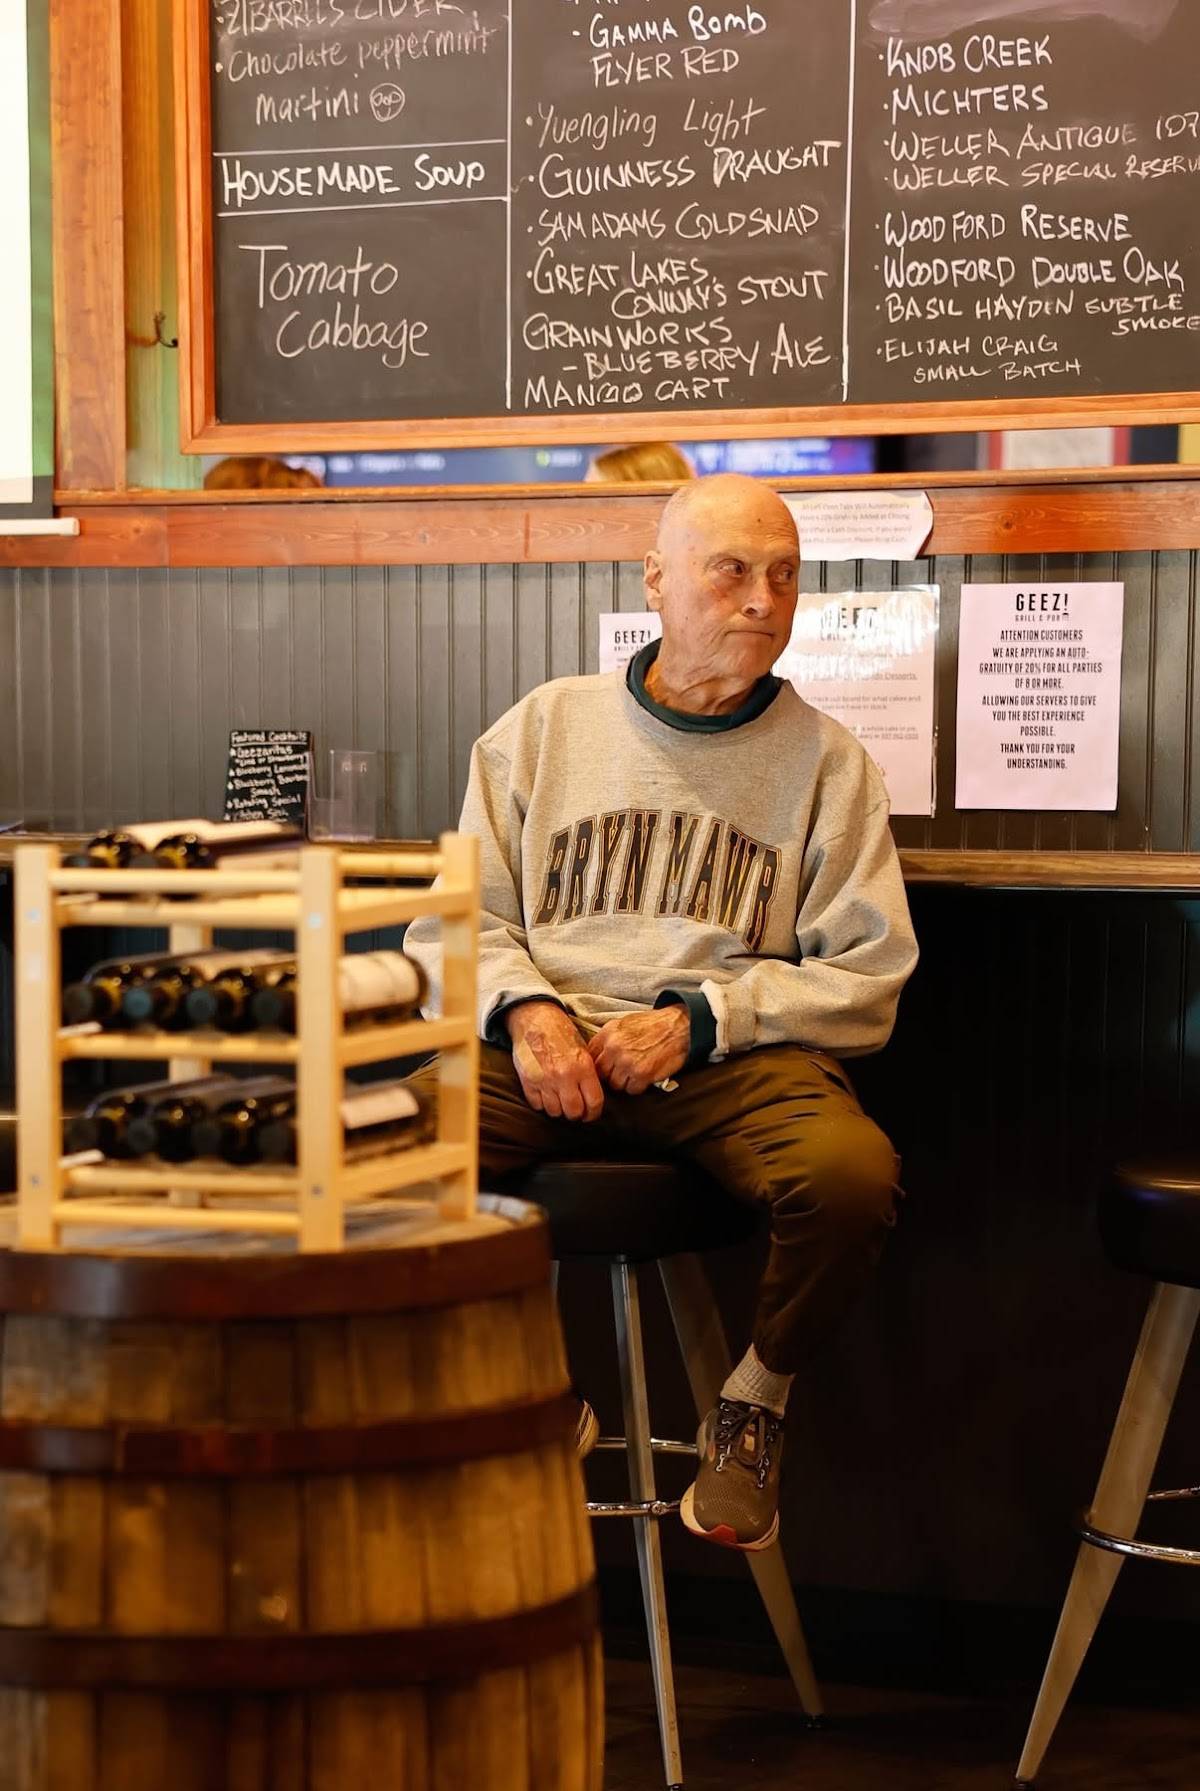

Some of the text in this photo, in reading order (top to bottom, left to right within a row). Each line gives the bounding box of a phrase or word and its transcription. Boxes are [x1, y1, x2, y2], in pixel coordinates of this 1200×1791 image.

[590, 13, 679, 49] GAMMA
[228, 22, 497, 82] Chocolate peppermint
[590, 46, 739, 88] FLYER RED
[887, 34, 1053, 78] KNOB CREEK
[892, 83, 1049, 126] MICHTERS
[538, 98, 767, 150] Yuengling Light
[890, 128, 1010, 162] WELLER
[1155, 111, 1199, 140] 107
[414, 153, 486, 191] SOUP
[539, 140, 842, 199] GUINNESS DRAUGHT
[893, 154, 1200, 190] WELLER SPECIAL RESERV
[1021, 204, 1132, 243] RESERVE
[238, 245, 398, 308] Tomato
[534, 247, 709, 296] GREAT LAKES
[883, 246, 1185, 292] WOODFORD DOUBLE OAK
[737, 270, 828, 306] STOUT
[885, 292, 963, 325] BASIL
[975, 289, 1074, 320] HAYDEN
[276, 301, 430, 368] Cabbage
[1111, 316, 1200, 336] SMOKE
[772, 322, 831, 375] ALE
[885, 334, 1058, 362] ELIJAH CRAIG
[655, 377, 731, 401] CART
[913, 358, 1082, 384] SMALL BATCH
[1016, 593, 1068, 611] GEEZ!
[993, 648, 1003, 658] WE
[1005, 648, 1018, 658] ARE
[1021, 648, 1054, 658] APPLYING
[1056, 648, 1066, 657] AN
[1000, 629, 1083, 641] ATTENTION CUSTOMERS
[979, 663, 1012, 673] GRATUITY
[1015, 663, 1023, 673] OF
[1043, 663, 1056, 673] FOR
[1057, 663, 1070, 673] ALL
[1072, 663, 1102, 673] PARTIES
[1015, 678, 1023, 689] OF
[1032, 678, 1041, 688] OR
[982, 695, 1096, 705] ALLOWING OUR SERVERS TO GIVE
[992, 711, 1085, 721] YOU THE BEST EXPERIENCE
[1000, 743, 1075, 753] THANK YOU FOR YOUR
[1020, 726, 1056, 737] POSSIBLE.
[1007, 758, 1067, 769] UNDERSTANDING.
[530, 808, 782, 952] BRYN MAWR
